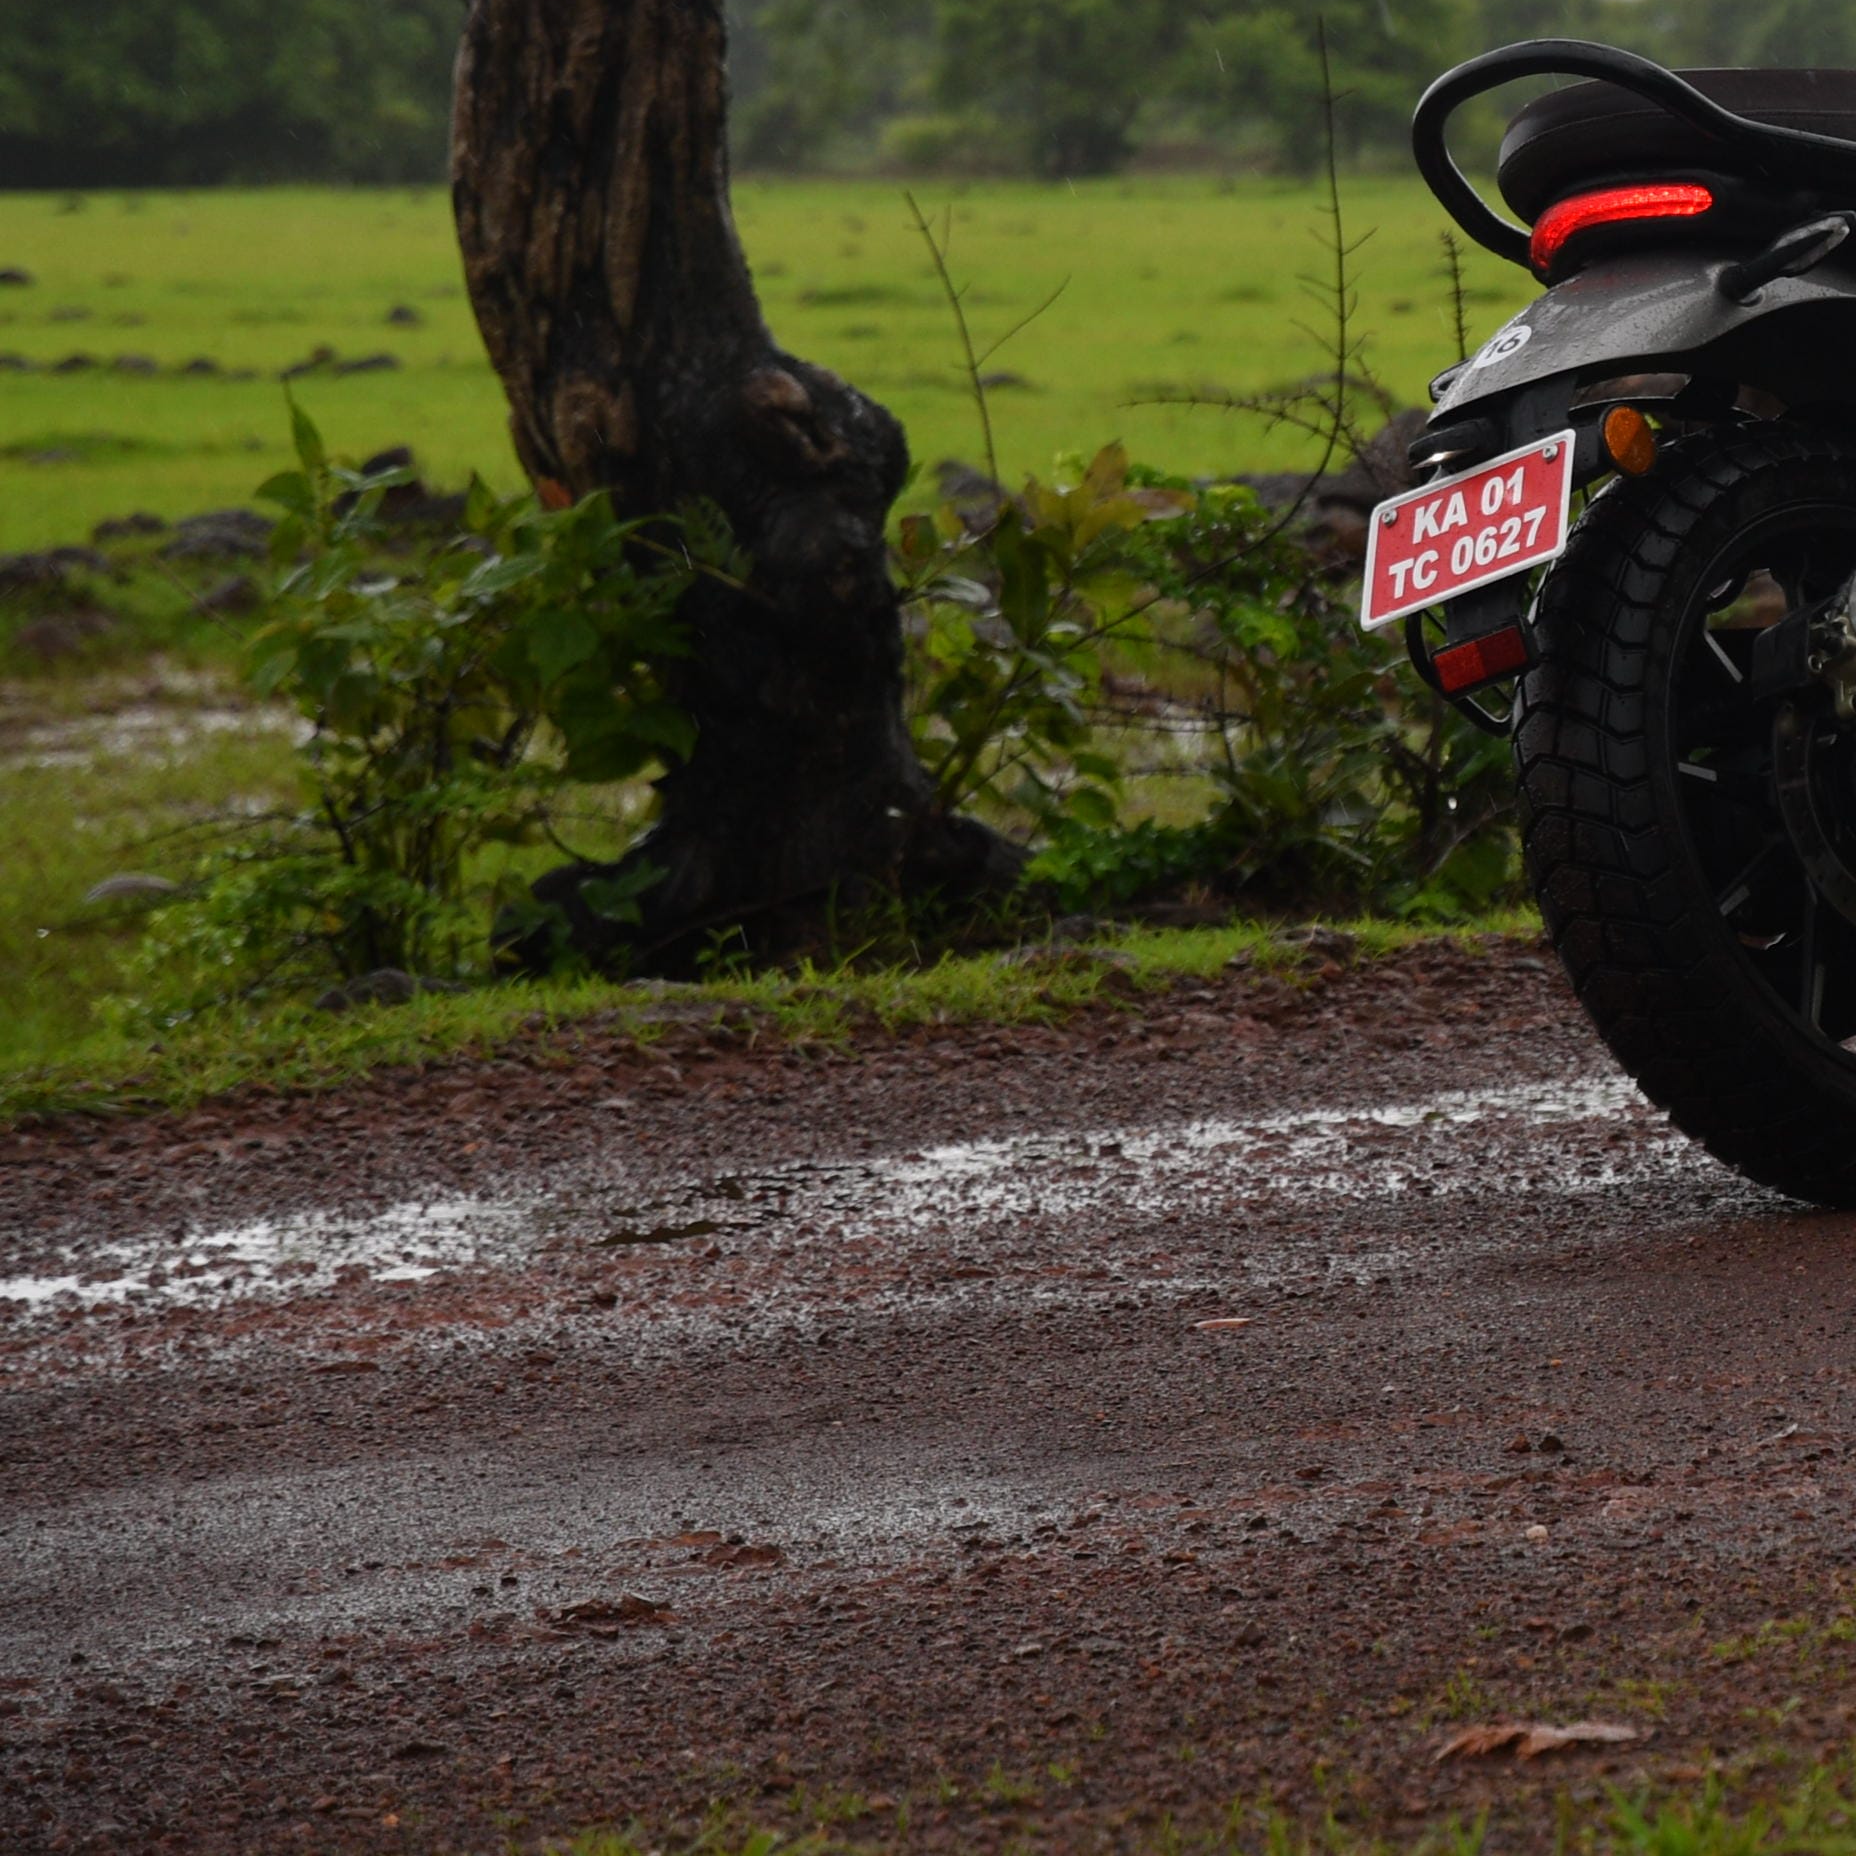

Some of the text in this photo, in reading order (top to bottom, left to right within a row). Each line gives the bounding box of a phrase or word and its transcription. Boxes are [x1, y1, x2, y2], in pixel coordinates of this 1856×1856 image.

[1485, 332, 1522, 359] 16
[1412, 466, 1525, 544] KA 01
[1388, 505, 1547, 599] TC 0627
